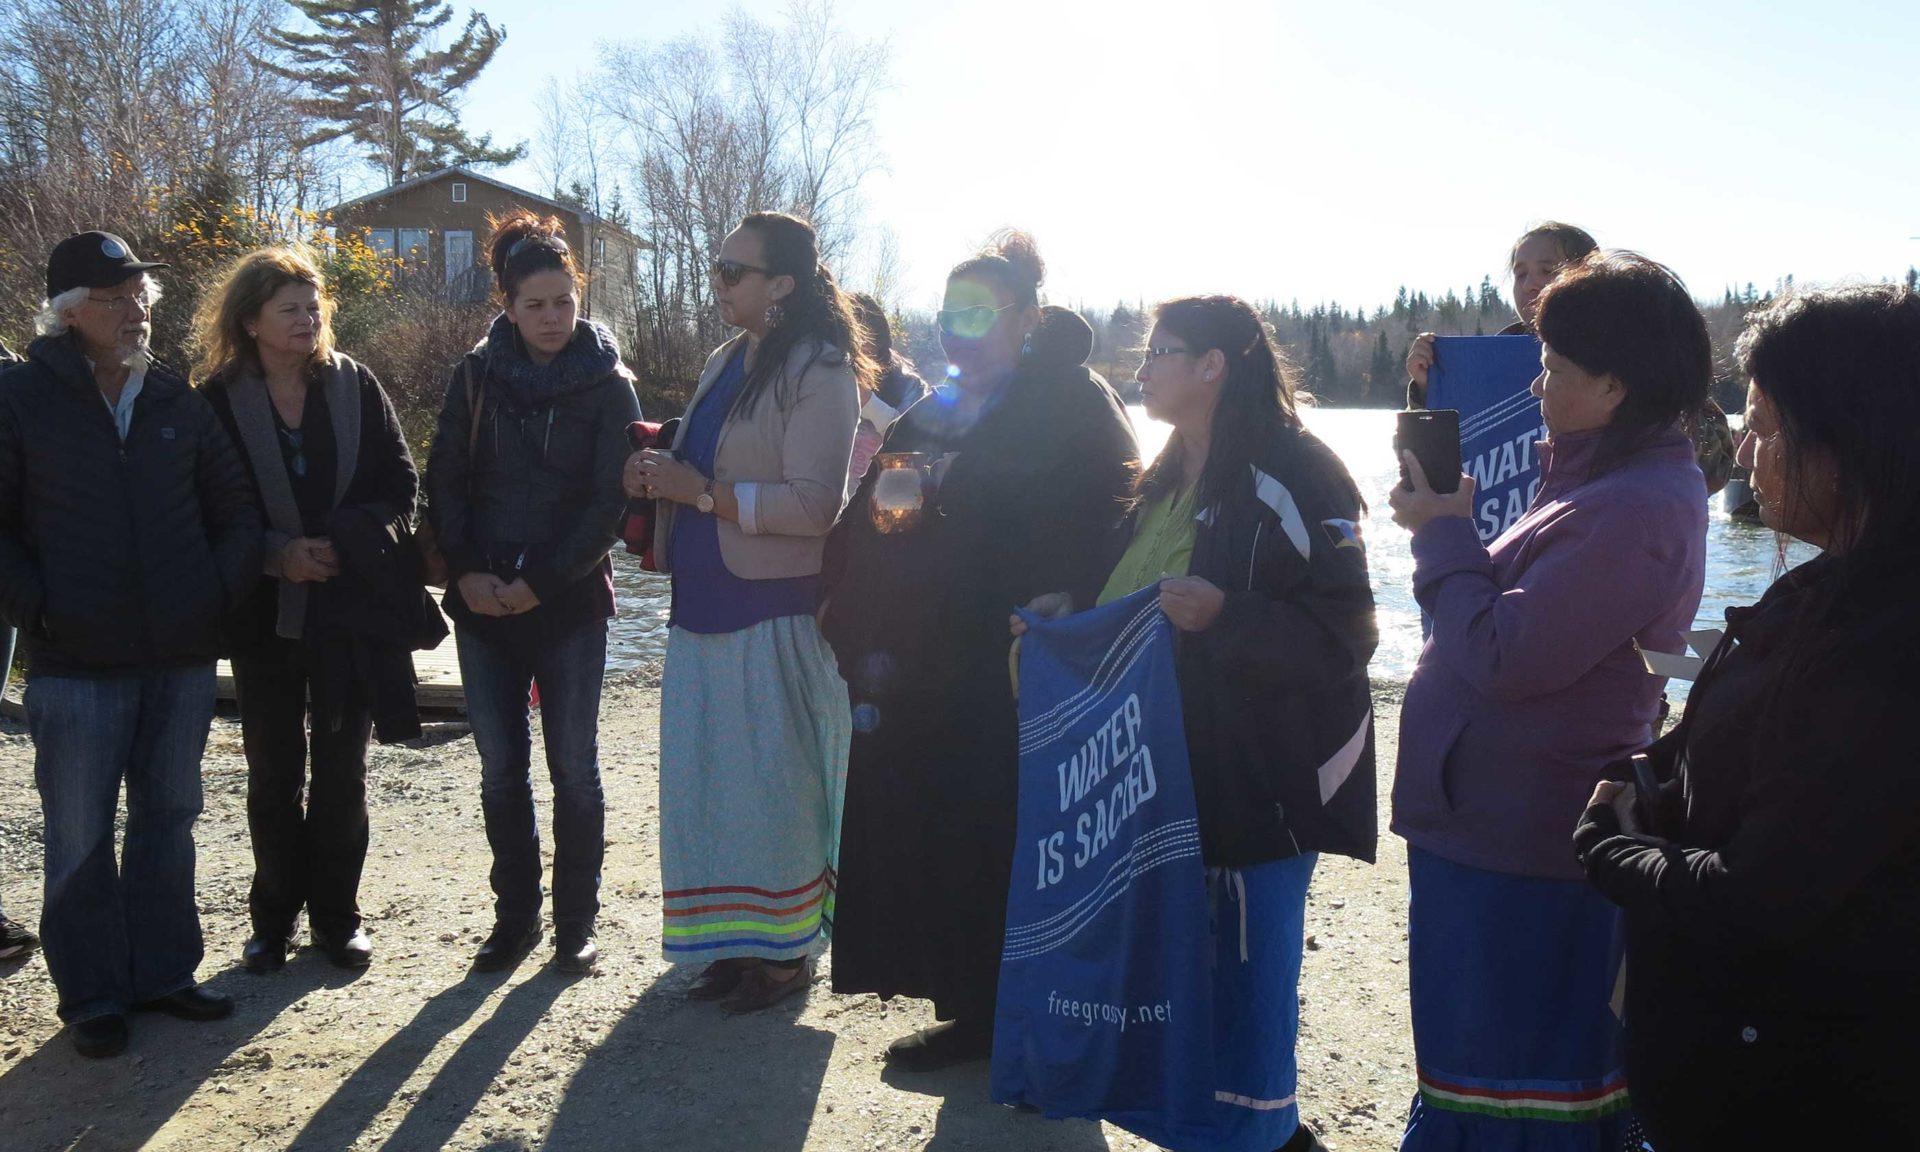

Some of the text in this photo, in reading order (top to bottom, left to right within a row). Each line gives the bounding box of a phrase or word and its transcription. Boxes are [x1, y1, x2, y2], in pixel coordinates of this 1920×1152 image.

[1057, 693, 1142, 812] WATER
[1036, 831, 1064, 890] IS
[1047, 990, 1172, 1032] freegrassy.net
